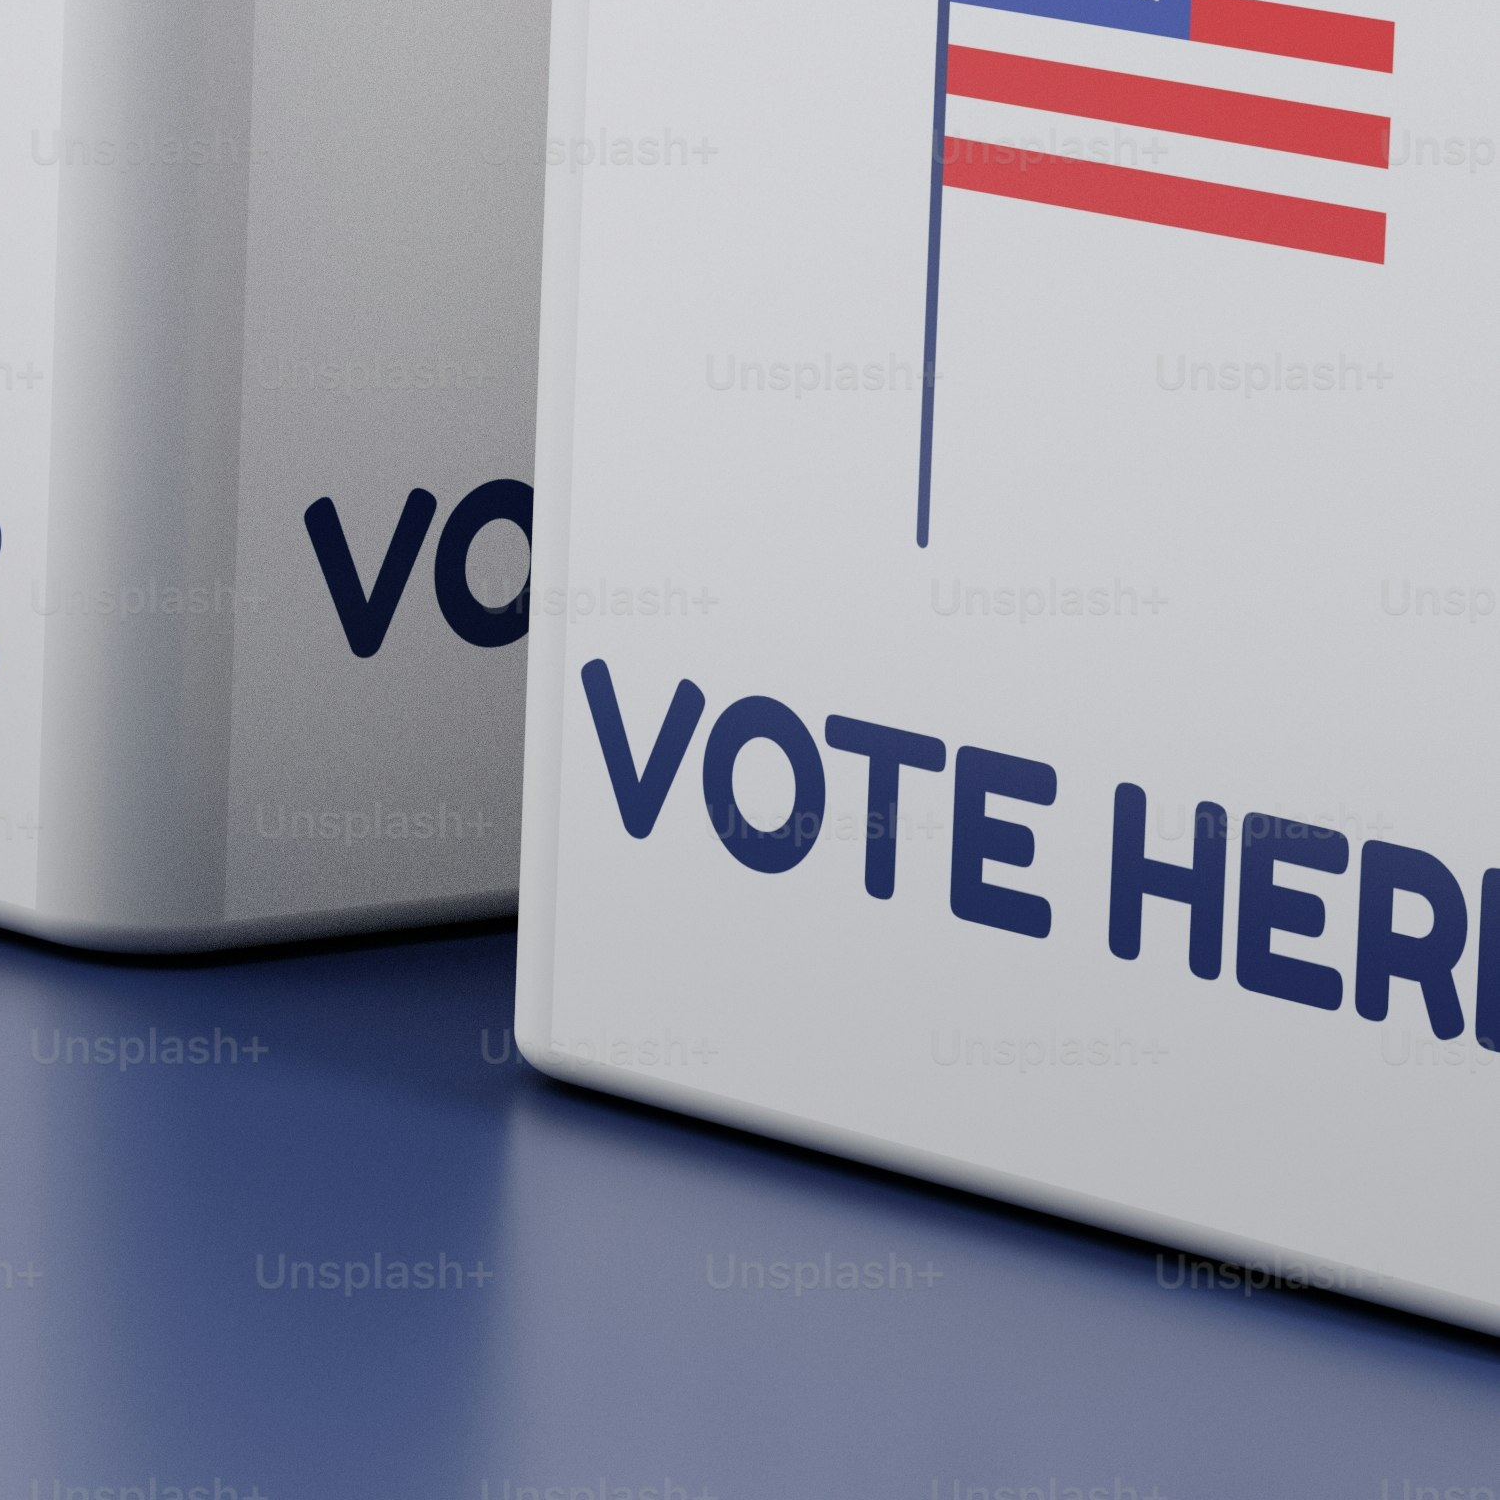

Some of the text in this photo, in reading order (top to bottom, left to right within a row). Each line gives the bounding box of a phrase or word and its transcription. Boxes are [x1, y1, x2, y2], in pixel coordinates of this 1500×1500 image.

[304, 479, 534, 658] VO
[581, 659, 1500, 1053] VOTE HER
